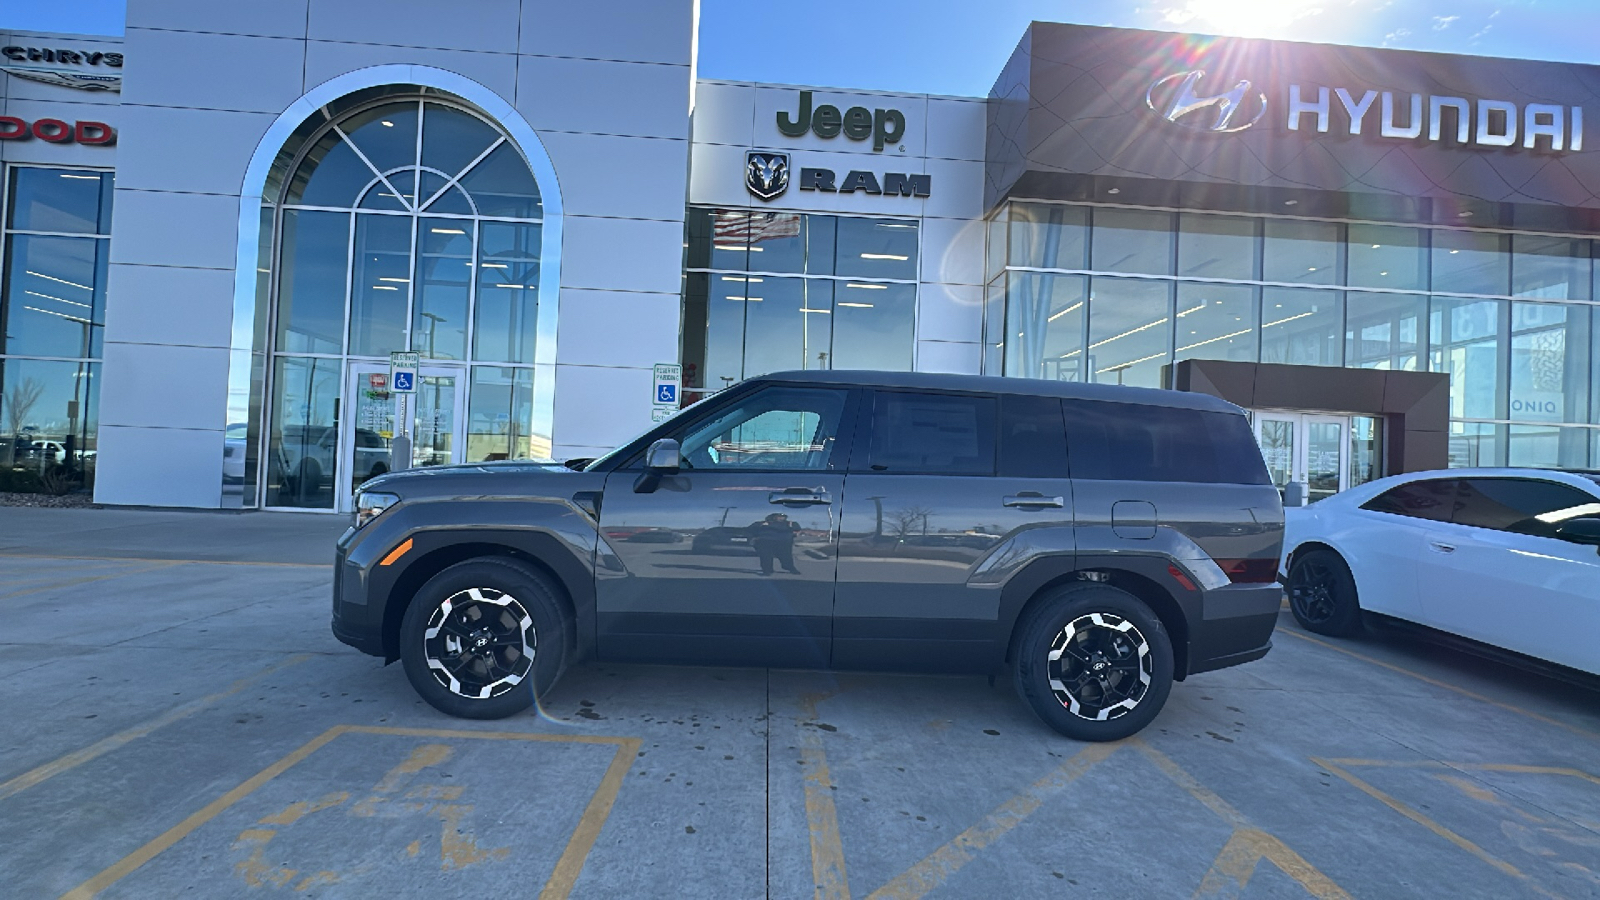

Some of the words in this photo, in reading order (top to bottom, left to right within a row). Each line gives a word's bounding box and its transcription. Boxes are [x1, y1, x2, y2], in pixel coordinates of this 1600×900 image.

[1, 46, 124, 68] CHRYS
[0, 115, 118, 146] DOD
[776, 91, 906, 151] Jeep
[1287, 84, 1583, 151] HYUNDAI
[800, 167, 931, 198] RAM
[392, 361, 417, 369] PARKING
